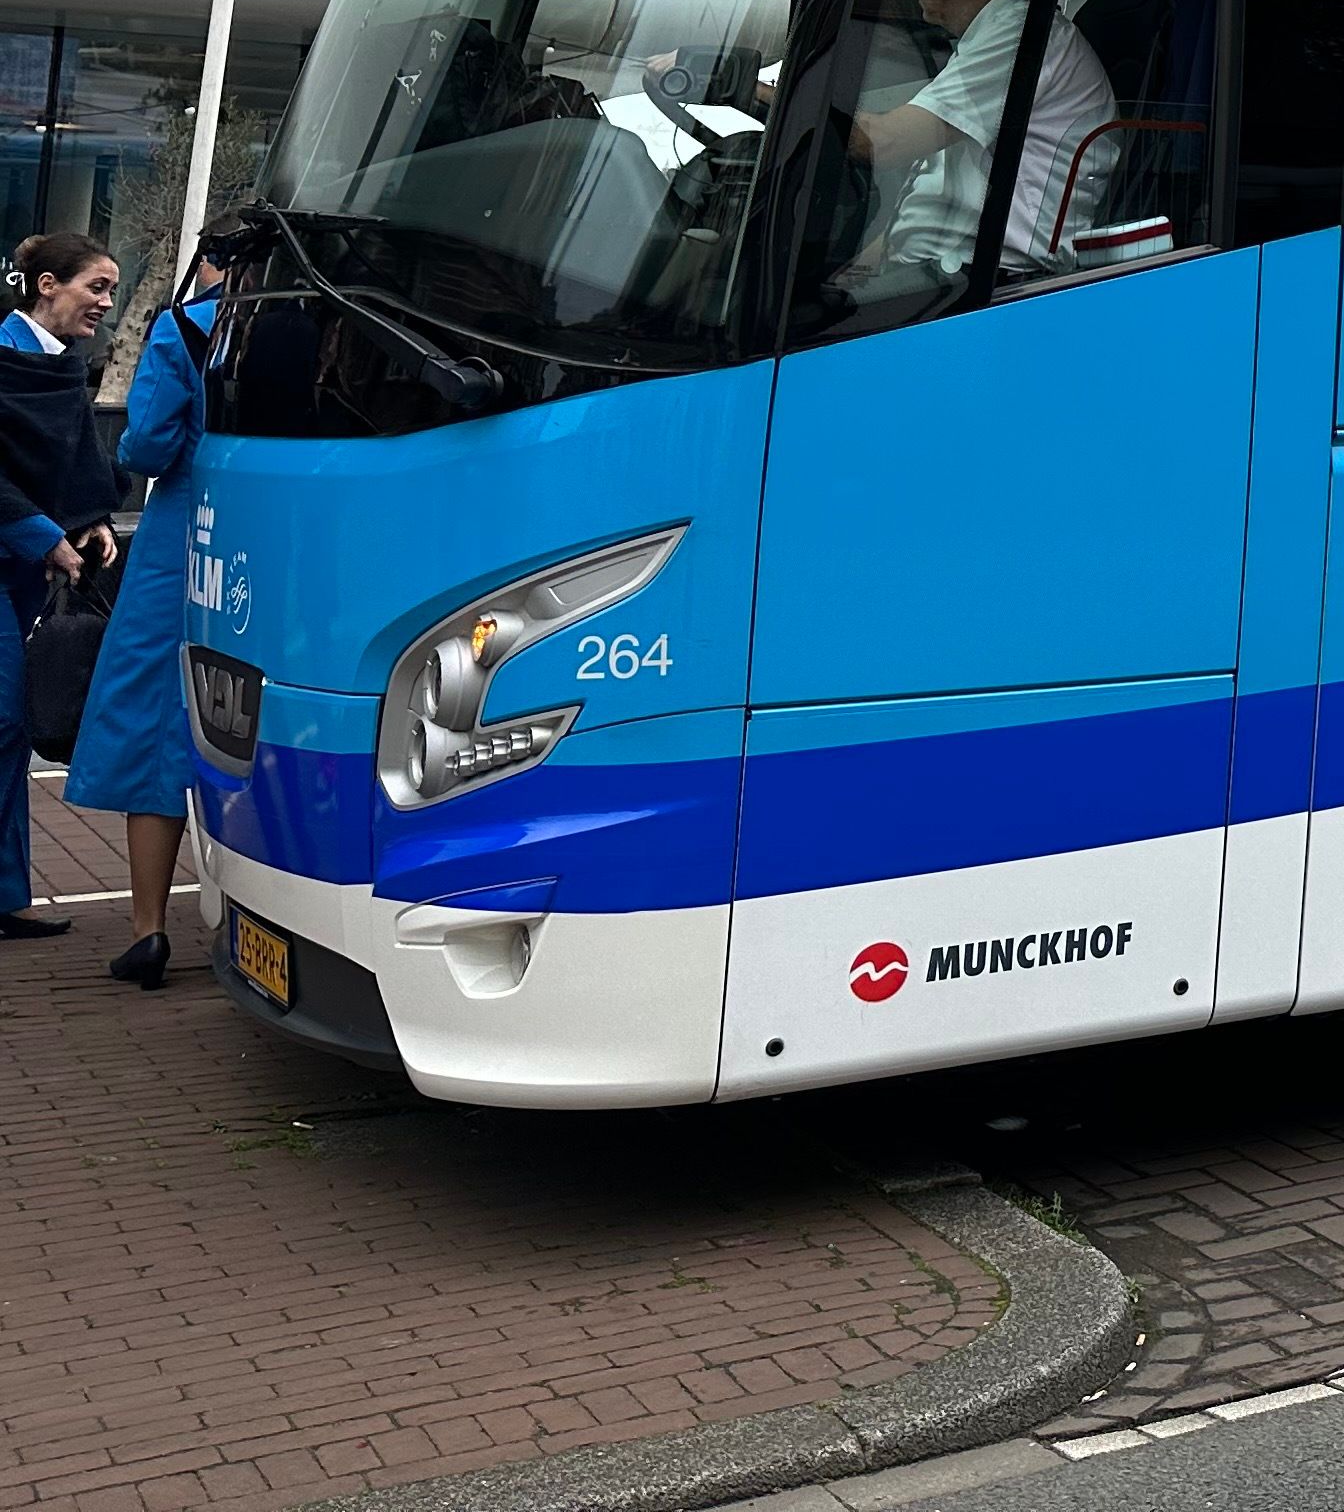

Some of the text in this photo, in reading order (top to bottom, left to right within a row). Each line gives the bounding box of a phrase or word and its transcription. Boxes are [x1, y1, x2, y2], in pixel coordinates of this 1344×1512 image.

[576, 634, 673, 679] 264
[239, 921, 288, 993] 25-BRR-4
[925, 922, 1133, 982] MUNCKHOF
